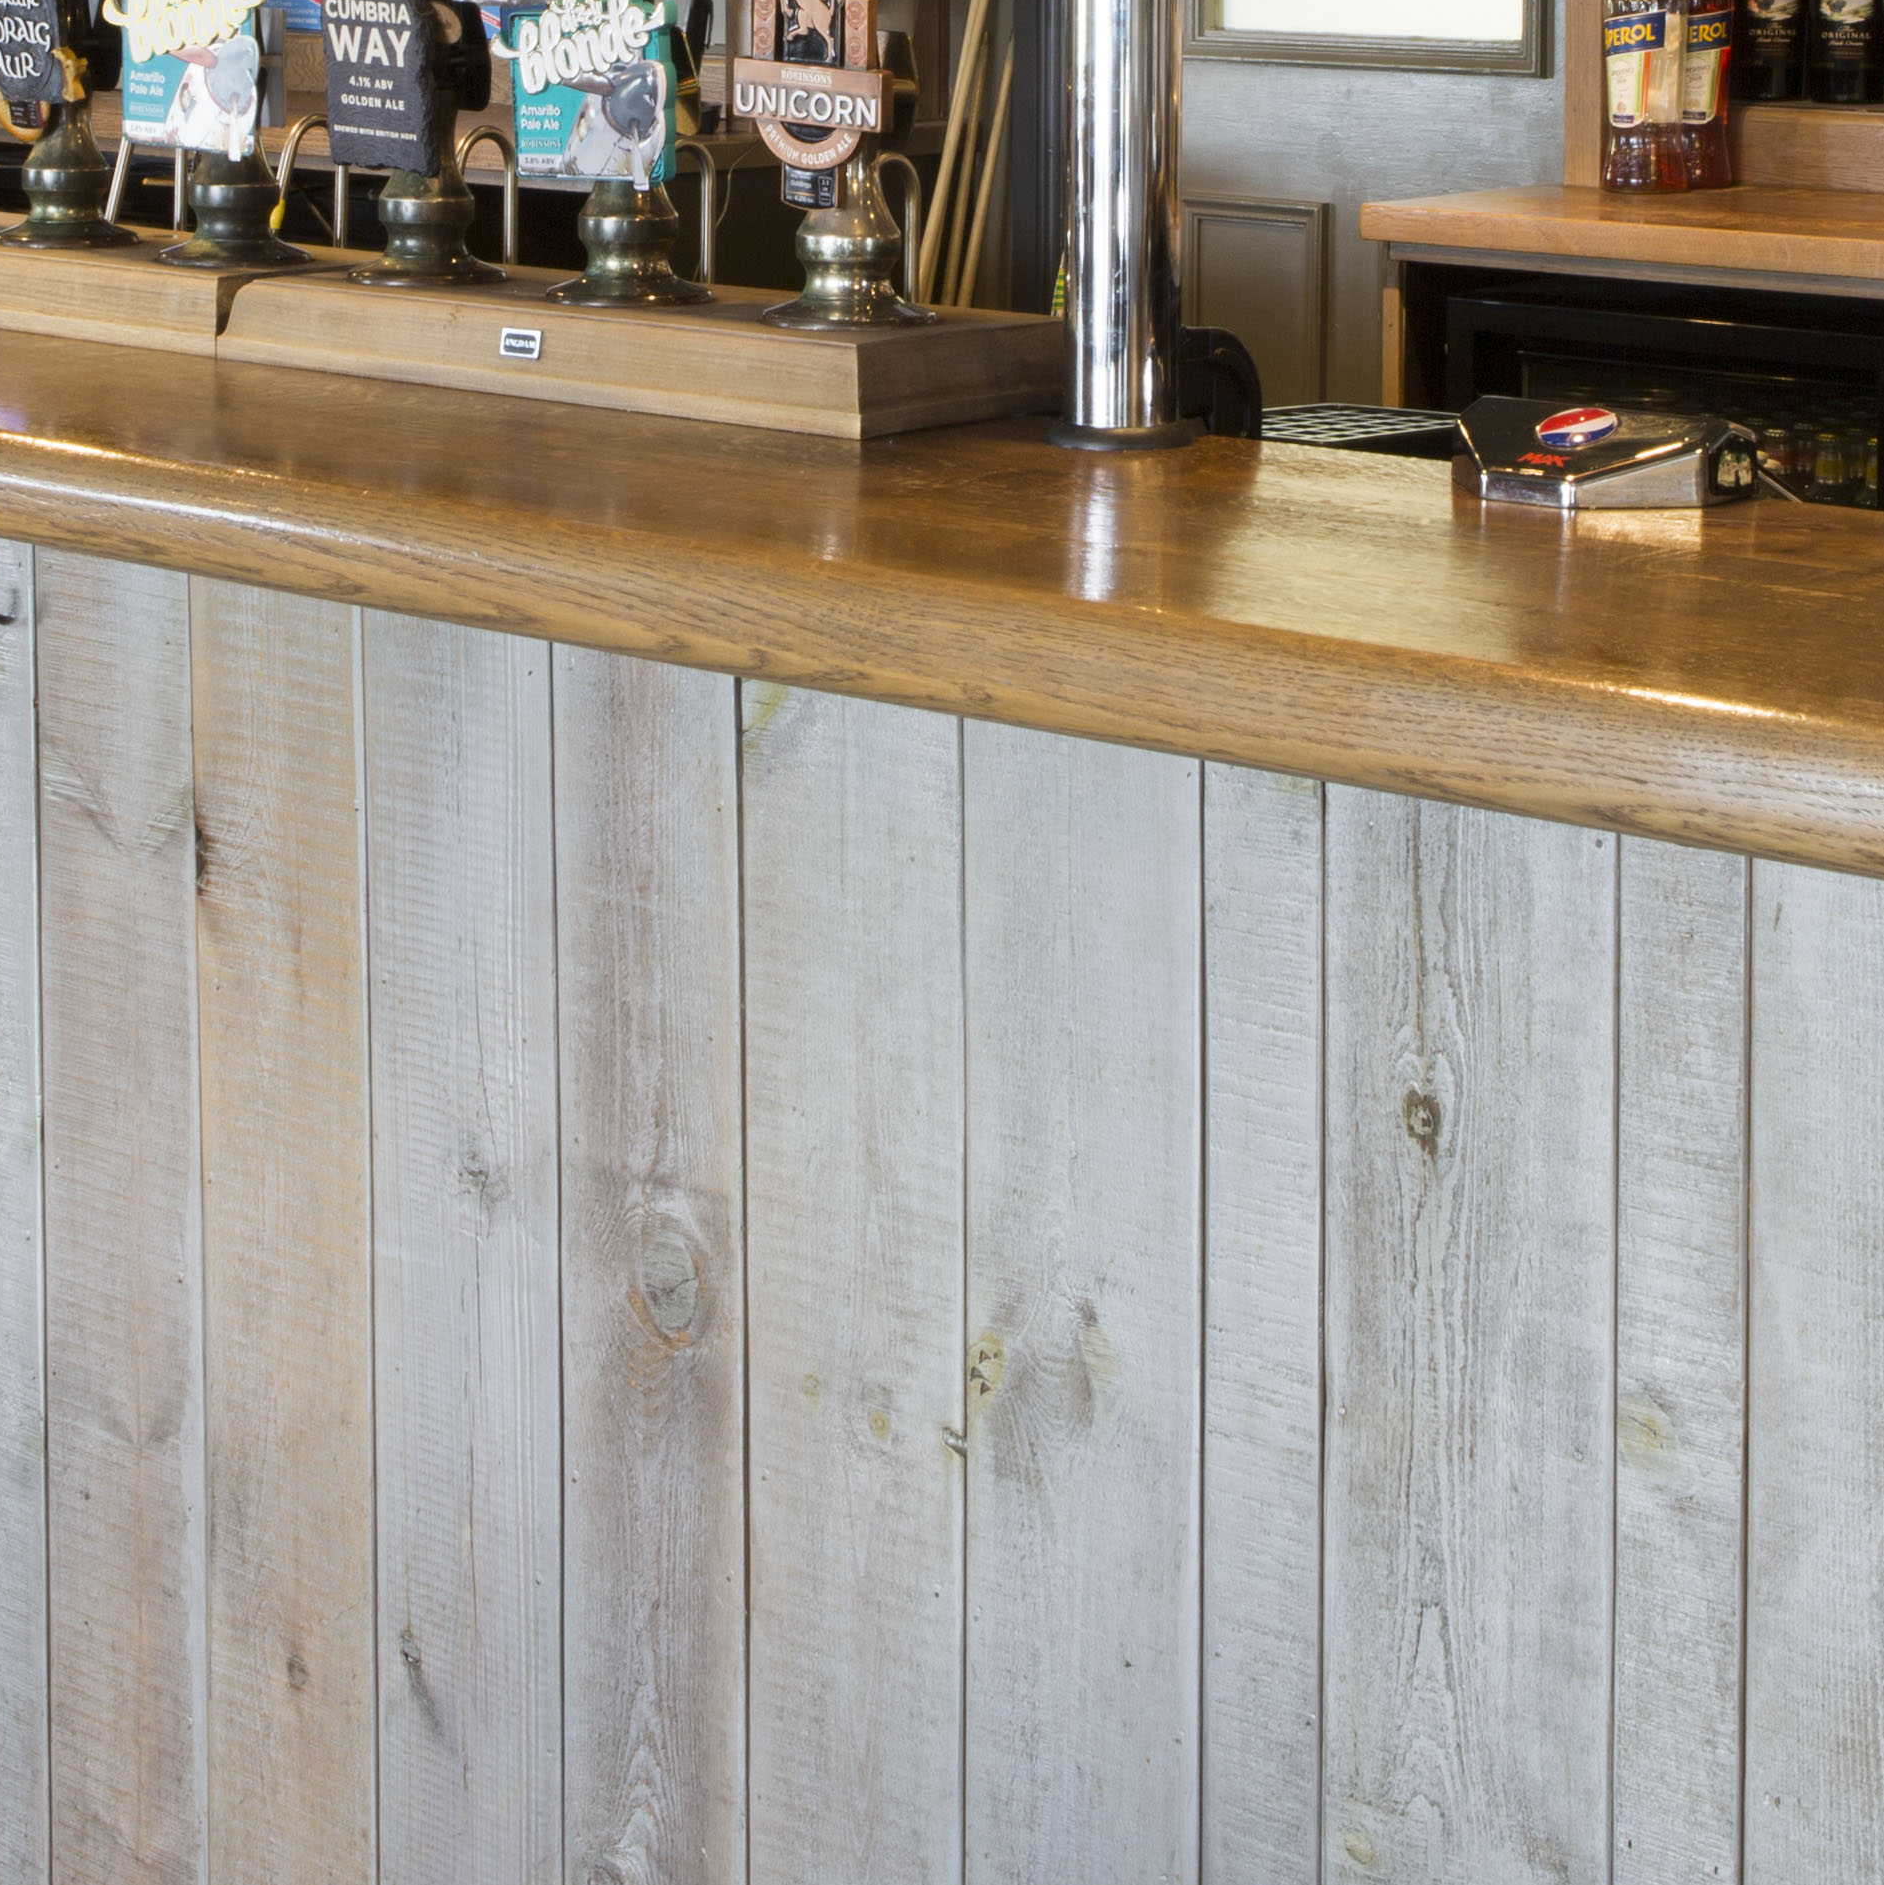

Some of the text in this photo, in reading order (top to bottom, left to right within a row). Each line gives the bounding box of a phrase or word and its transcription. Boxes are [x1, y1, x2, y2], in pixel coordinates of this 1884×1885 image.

[1748, 28, 1796, 36] ORIGINAL
[1821, 31, 1871, 40] ORIGINAL
[327, 22, 411, 67] WAY
[130, 70, 166, 83] Amarillo
[349, 75, 394, 91] 4.1% ABV
[781, 69, 833, 86] ROBINSONS
[130, 83, 164, 97] Pale Ale
[341, 94, 405, 110] GOLDEN ALE
[520, 104, 561, 115] Amarillo
[736, 83, 878, 128] UNICORN
[334, 124, 417, 140] BREWED WITH BRITISH HOPS
[520, 118, 560, 130] Pale Ale
[521, 139, 561, 148] ROBINSONS
[763, 124, 853, 166] PREMIUM GOLDEN ALE
[1518, 450, 1572, 469] MAX
